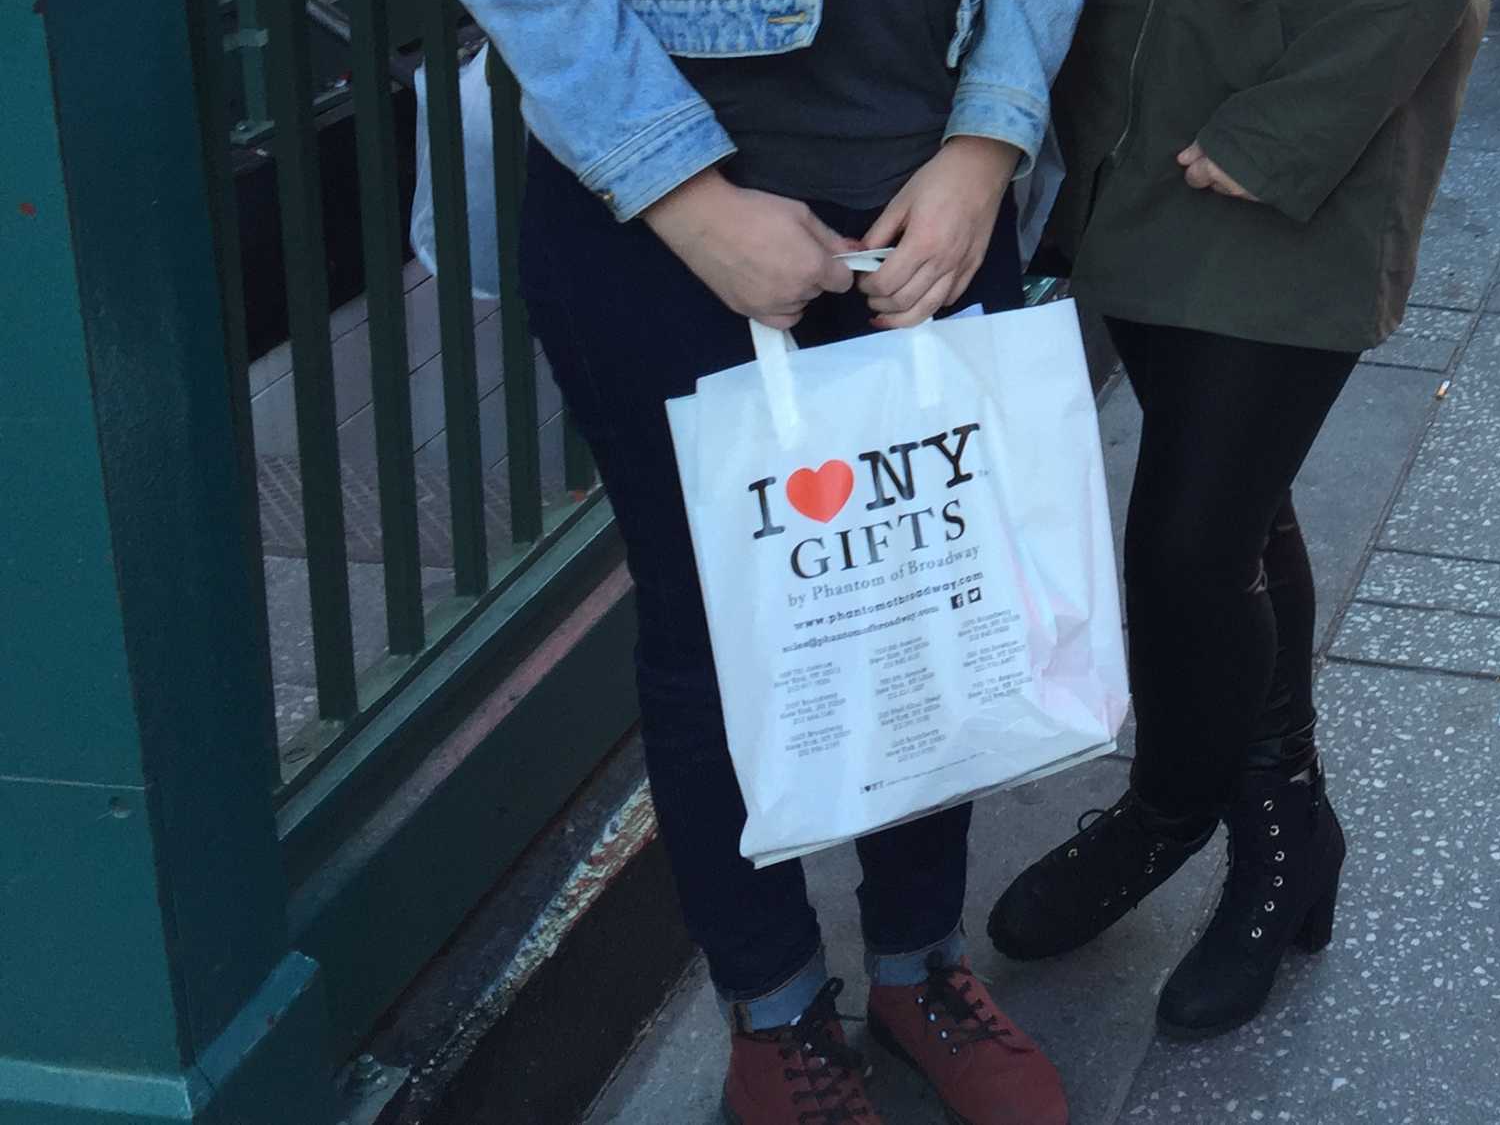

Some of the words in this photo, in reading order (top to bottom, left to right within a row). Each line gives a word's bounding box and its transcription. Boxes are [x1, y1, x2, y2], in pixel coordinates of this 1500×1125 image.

[748, 476, 786, 540] I
[858, 423, 980, 512] NY
[790, 499, 967, 580] GIFTS
[812, 576, 886, 601] Phantom
[908, 545, 981, 574] Broadway
